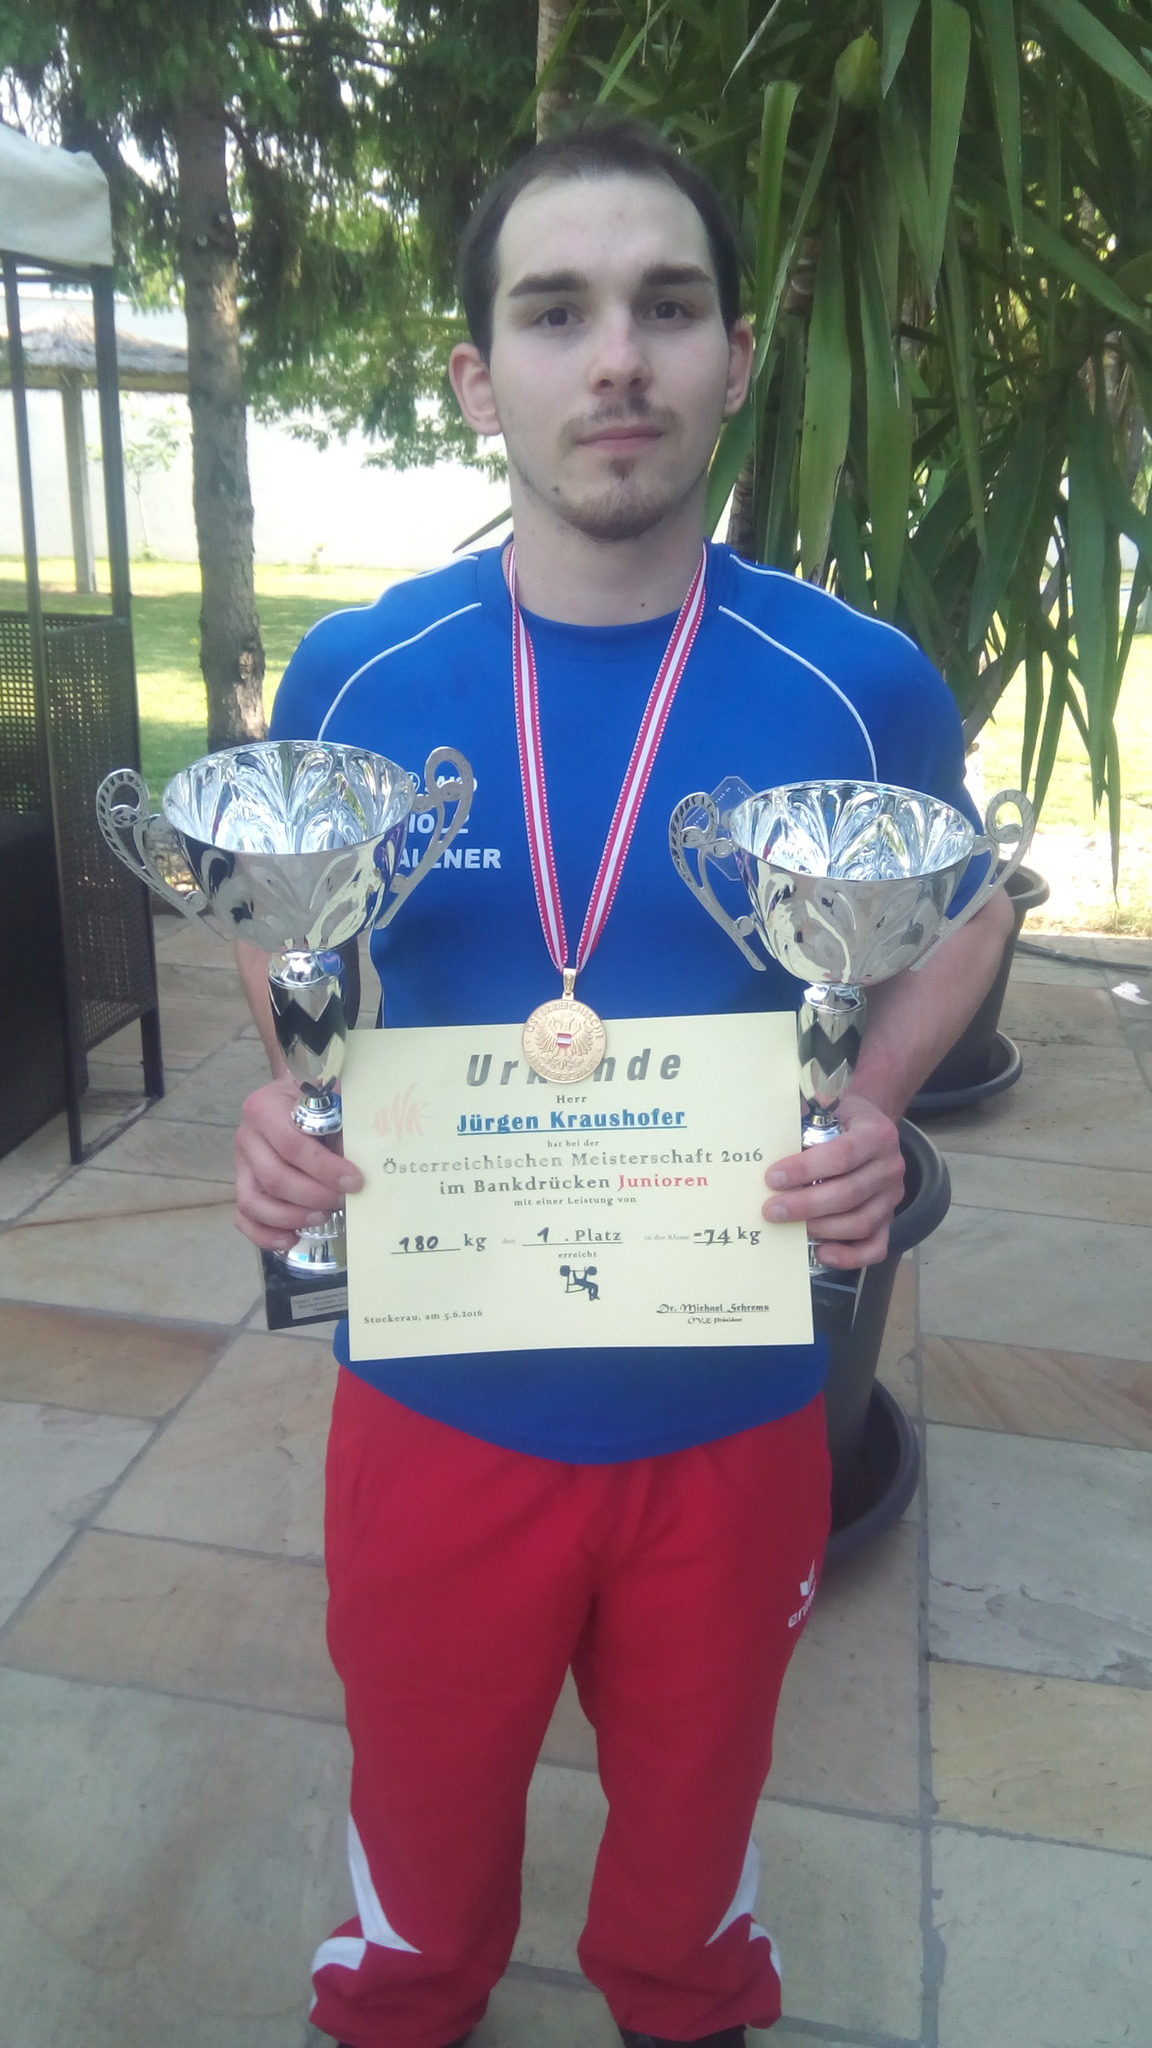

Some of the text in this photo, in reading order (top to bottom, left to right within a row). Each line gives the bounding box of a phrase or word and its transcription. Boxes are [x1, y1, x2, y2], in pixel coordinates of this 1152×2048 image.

[466, 1048, 682, 1087] Urnde
[555, 1094, 588, 1104] Herr
[457, 1108, 686, 1134] Jürgen Kraushofer
[547, 1139, 600, 1148] hat bei der
[382, 1147, 764, 1175] Österreichischen Meisterschaft 2016
[440, 1173, 709, 1195] im Bankdrücken Junioren
[513, 1196, 637, 1207] mit einer Leistung von
[398, 1234, 439, 1253] 180
[463, 1233, 488, 1252] kg
[575, 1228, 622, 1242] Platz
[693, 1228, 732, 1247] -74
[736, 1226, 762, 1246] kg
[558, 1250, 598, 1259] erreicht
[656, 1302, 770, 1314] Dr. Michael Schrems
[363, 1314, 422, 1324] Stockerau,
[443, 1309, 483, 1321] 5.6.2016
